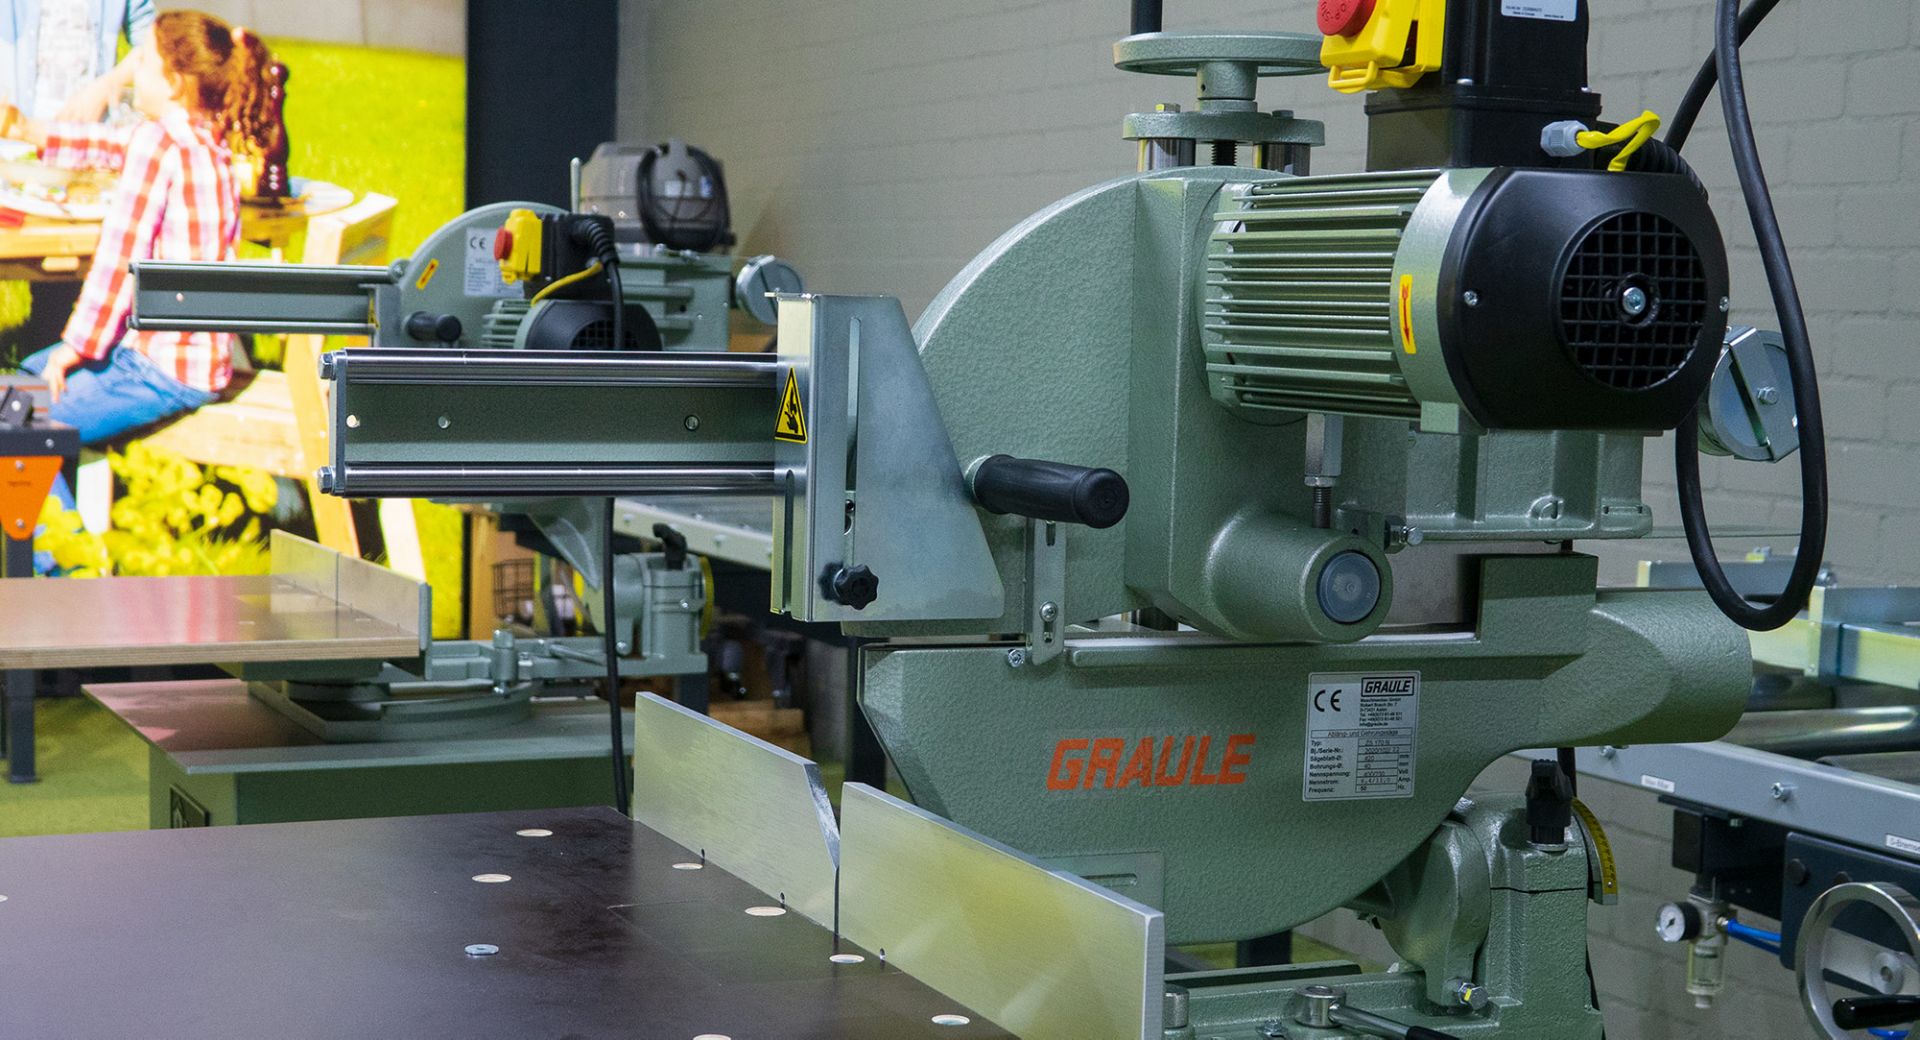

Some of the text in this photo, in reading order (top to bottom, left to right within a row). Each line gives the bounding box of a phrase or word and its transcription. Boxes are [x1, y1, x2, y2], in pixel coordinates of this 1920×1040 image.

[1364, 680, 1411, 694] GRAULE
[1314, 689, 1342, 712] CE
[1046, 733, 1256, 791] GRAULE
